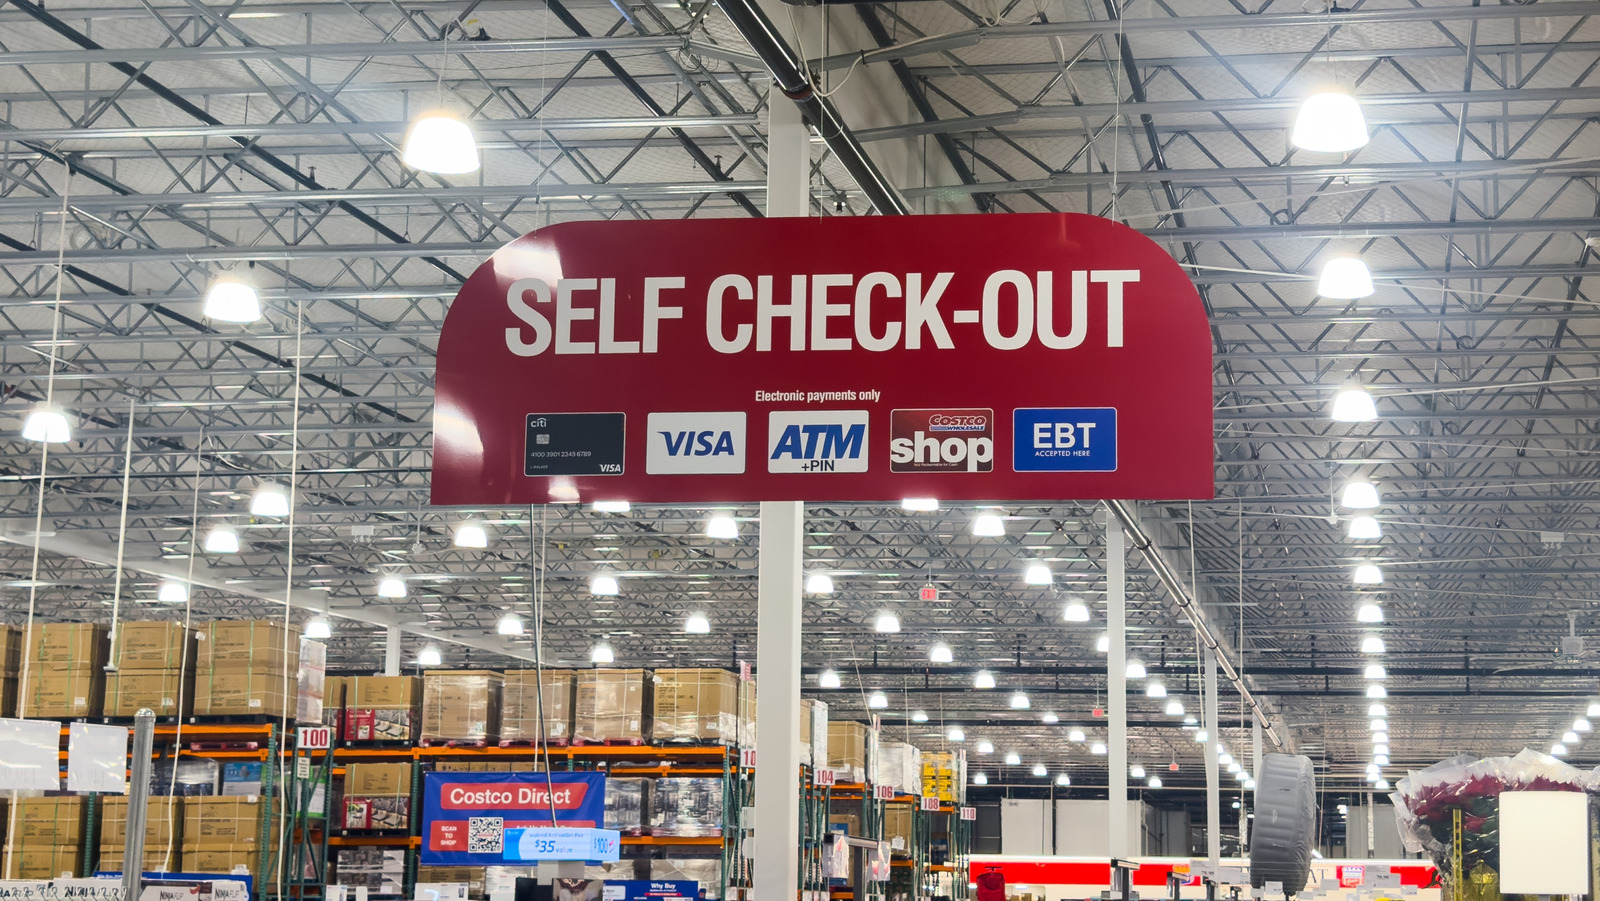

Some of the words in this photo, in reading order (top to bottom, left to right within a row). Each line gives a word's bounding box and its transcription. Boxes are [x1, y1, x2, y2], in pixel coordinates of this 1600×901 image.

[505, 276, 686, 357] SELF
[706, 269, 1141, 354] CHECK-OUT
[755, 390, 805, 402] Electronic
[807, 390, 857, 403] payments
[859, 389, 881, 403] only
[530, 417, 547, 428] citi
[770, 424, 866, 459] ATM
[1033, 422, 1097, 449] EBT
[657, 430, 735, 456] VISA
[891, 431, 994, 473] shop
[599, 464, 621, 472] VISA
[801, 460, 835, 472] +PIN
[302, 729, 328, 746] 100
[744, 751, 756, 766] 10
[816, 770, 834, 784] 104
[450, 788, 513, 804] Costco
[518, 788, 571, 804] Direct
[876, 786, 893, 798] 106
[923, 798, 939, 809] 108
[962, 809, 975, 819] 110
[535, 839, 556, 853] $35
